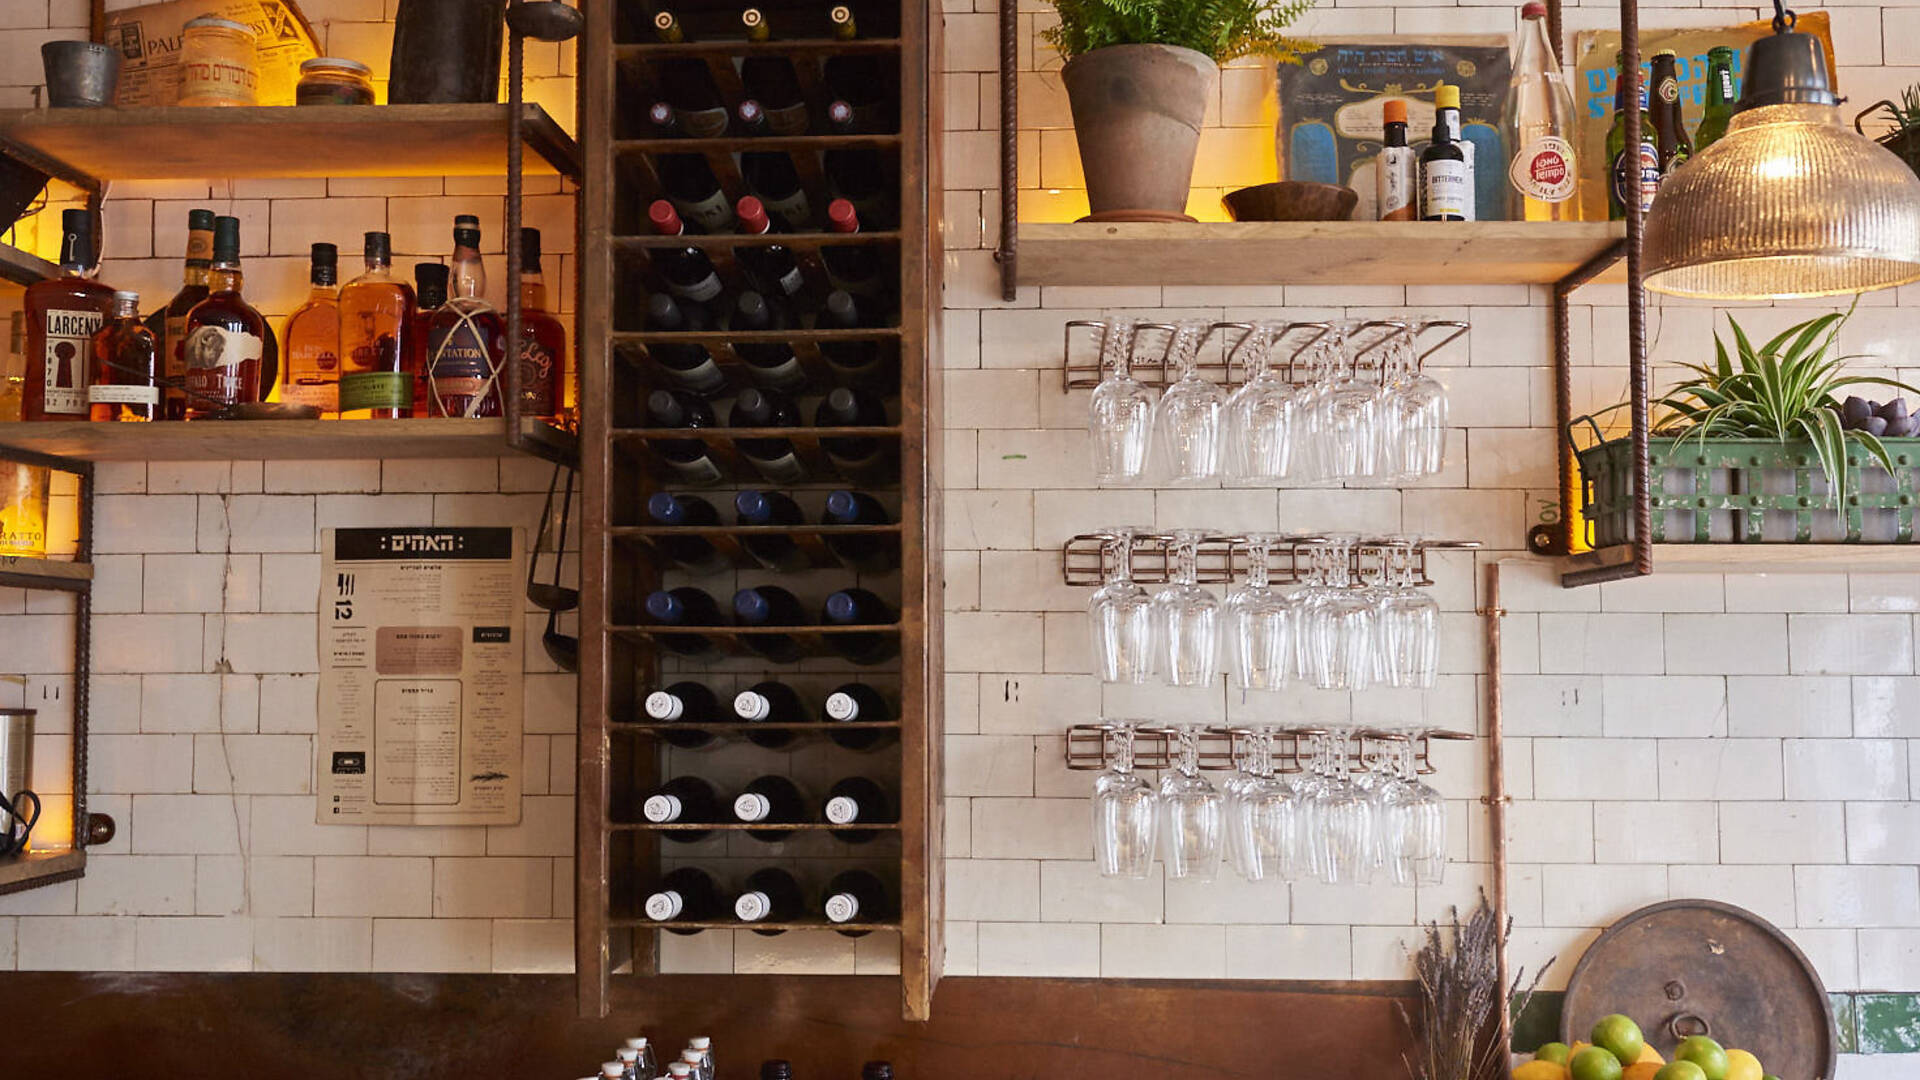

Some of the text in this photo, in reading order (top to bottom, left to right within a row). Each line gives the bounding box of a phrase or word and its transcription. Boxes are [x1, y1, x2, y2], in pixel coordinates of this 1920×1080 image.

[1534, 167, 1565, 181] Tempo
[47, 315, 102, 336] LARCENY
[334, 599, 353, 620] 12
